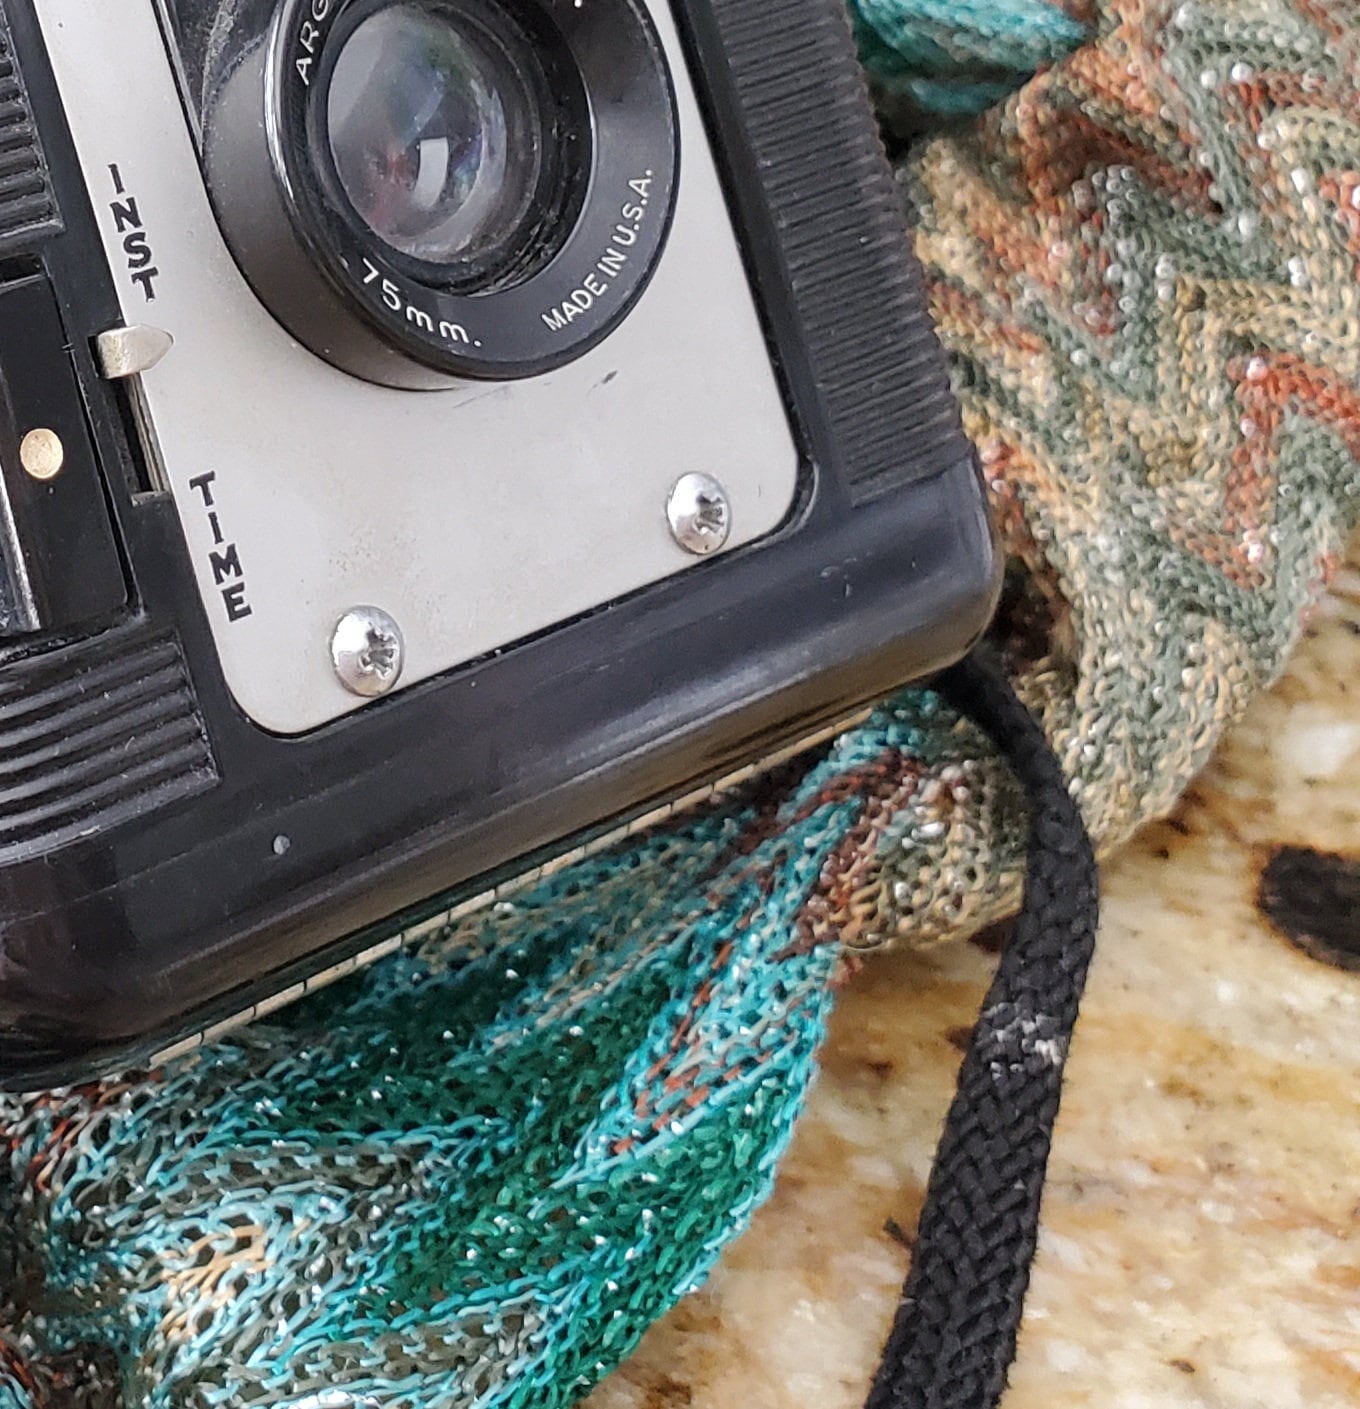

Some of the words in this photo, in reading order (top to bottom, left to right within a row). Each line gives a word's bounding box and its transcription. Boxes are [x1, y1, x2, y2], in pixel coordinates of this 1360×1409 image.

[107, 163, 160, 300] INST
[361, 257, 483, 348] 75mm.
[541, 273, 607, 331] MADE
[596, 247, 627, 277] IN
[613, 168, 653, 246] U.S.A.
[188, 470, 253, 623] TIME
